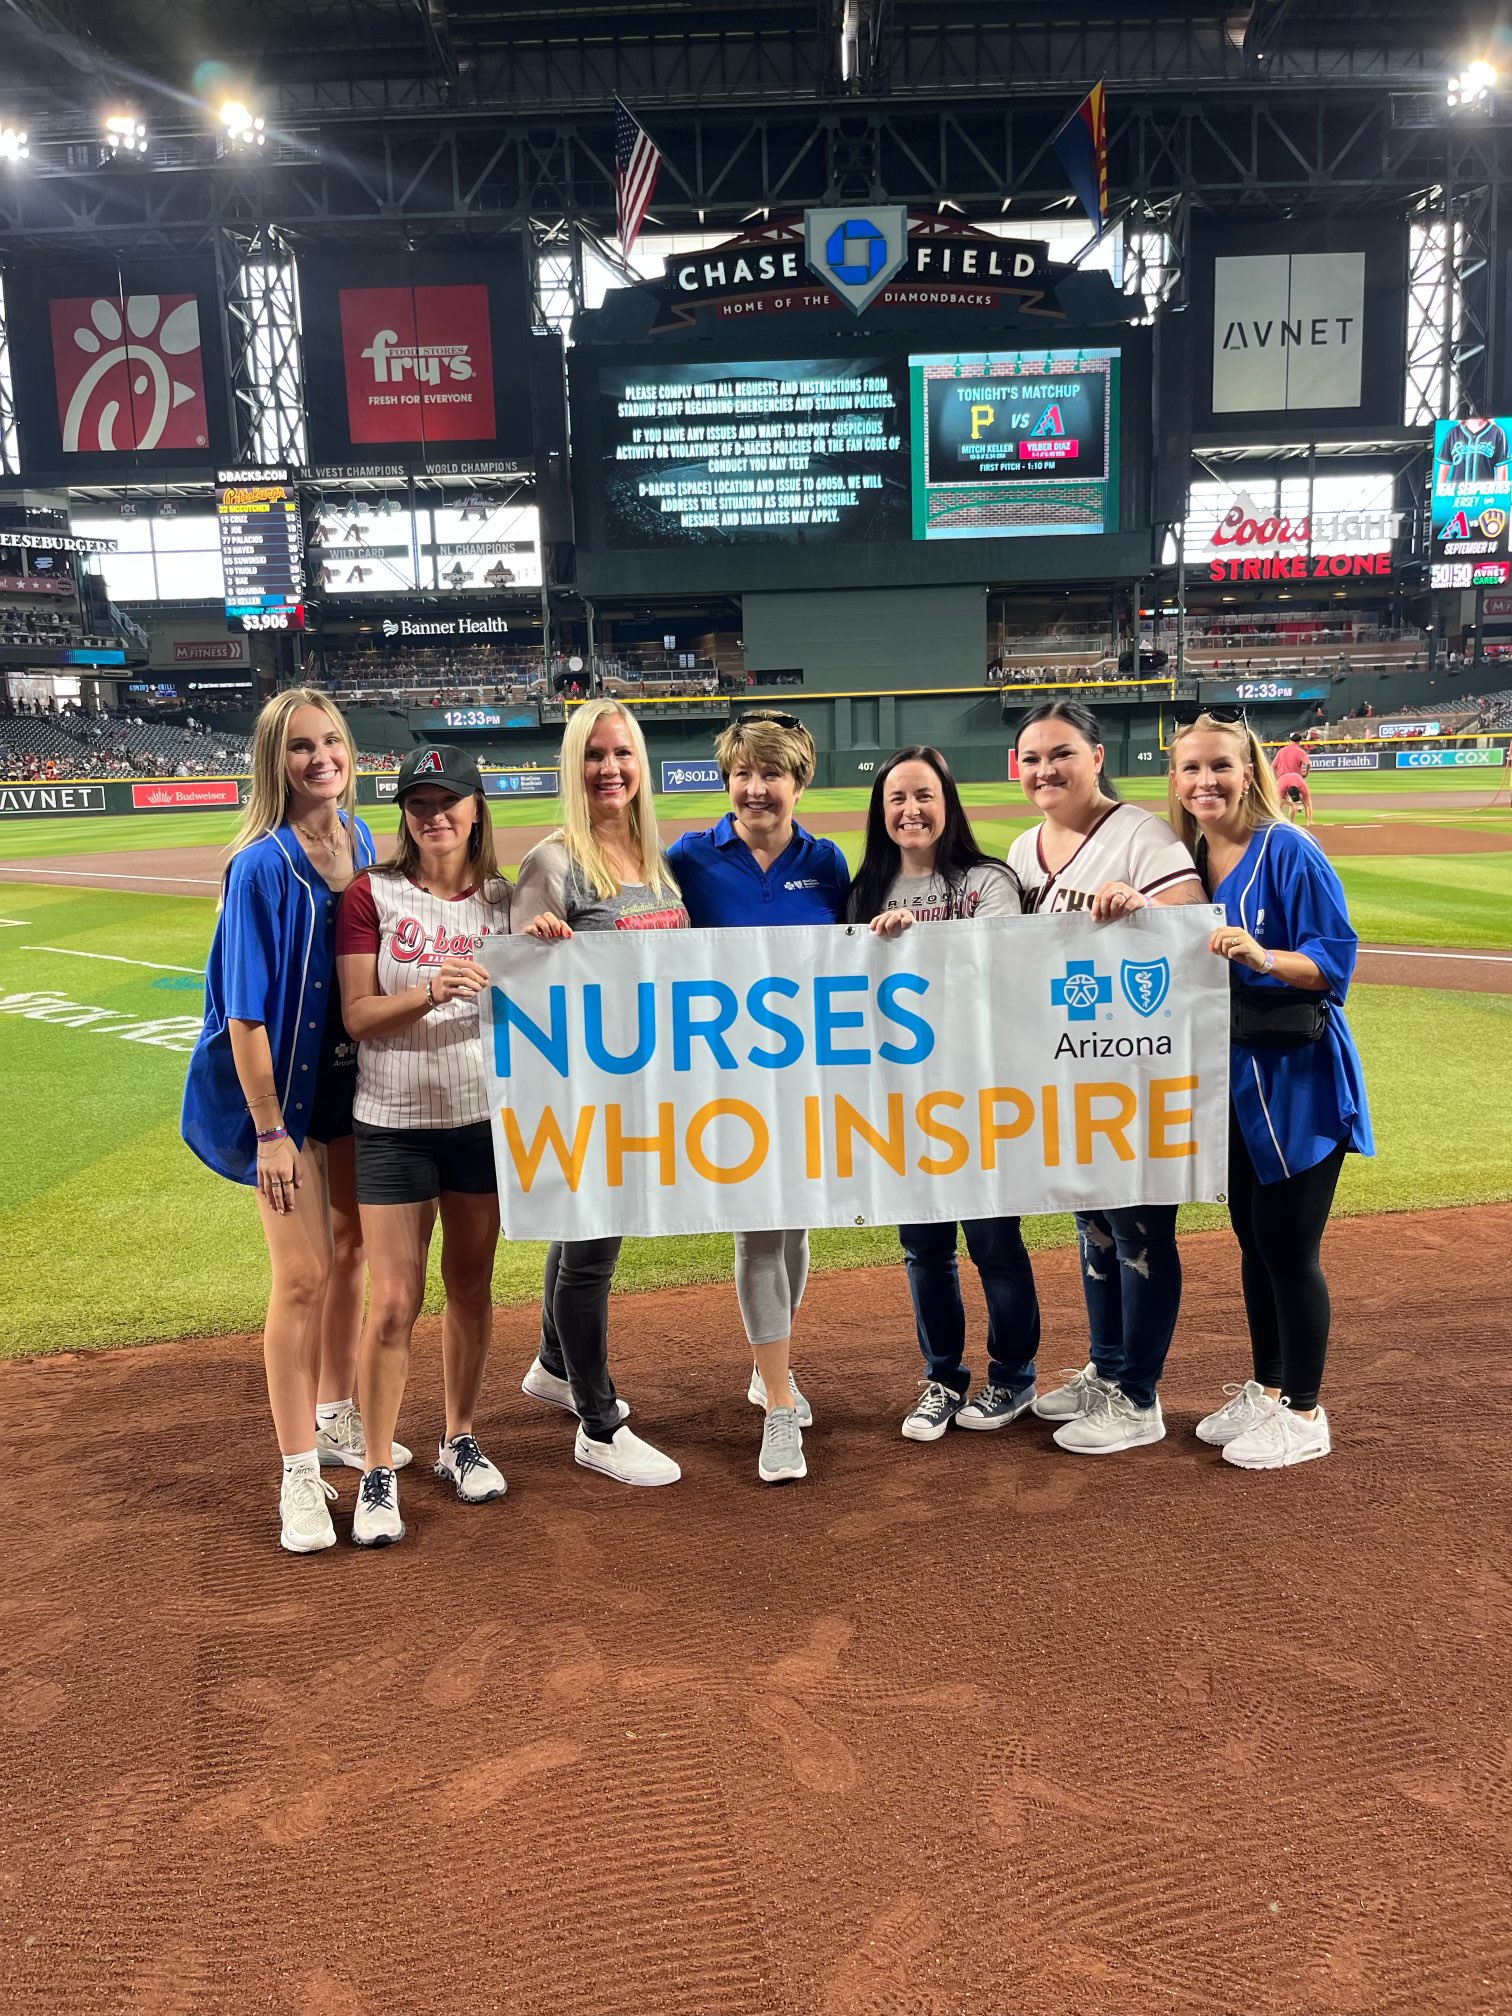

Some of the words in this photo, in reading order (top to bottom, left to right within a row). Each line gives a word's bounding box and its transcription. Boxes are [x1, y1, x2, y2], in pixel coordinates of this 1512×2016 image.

[678, 253, 797, 291] CHASE
[917, 248, 1035, 278] FIELD
[723, 301, 764, 315] HOME
[775, 298, 792, 309] OF
[803, 295, 830, 307] THE
[884, 292, 992, 305] DIAMONDBACKS
[1222, 316, 1353, 350] AVNET
[389, 347, 418, 356] FOOD
[423, 346, 465, 355] STORES
[626, 385, 657, 400] PLEASE
[659, 384, 692, 399] COMPLY
[694, 383, 716, 398] WITH
[718, 382, 733, 397] ALL
[735, 381, 778, 396] REQUESTS
[780, 381, 798, 394] AND
[800, 378, 861, 394] INSTRUCTIONS
[864, 378, 887, 392] FROM
[957, 386, 1018, 401] TONIGHT'S
[1022, 384, 1080, 399] MATCHUP
[368, 396, 398, 405] FRESH
[401, 395, 420, 404] FOR
[424, 394, 472, 403] EVERYONE
[618, 403, 656, 417] STADIUM
[658, 402, 683, 416] STAFF
[685, 400, 733, 415] REGARDING
[735, 398, 793, 413] EMERGENCIES
[795, 396, 813, 410] AND
[815, 396, 852, 410] STADIUM
[855, 394, 896, 408] POLICIES.
[1011, 414, 1030, 428] VS
[633, 428, 642, 442] IF
[644, 428, 661, 442] YOU
[663, 427, 685, 441] HAVE
[687, 427, 705, 440] ANY
[707, 426, 736, 440] ISSUES
[739, 424, 756, 439] AND
[758, 424, 782, 438] WANT
[784, 424, 795, 437] TO
[798, 423, 830, 437] REPORT
[832, 421, 883, 435] SUSPICIOUS
[616, 445, 655, 460] ACTIVITY
[656, 444, 670, 458] OR
[670, 443, 720, 458] VIOLATIONS
[722, 442, 732, 456] OF
[735, 441, 771, 455] D-BACKS
[774, 439, 811, 454] POLICIES
[813, 439, 826, 452] OR
[828, 438, 844, 452] THE
[846, 438, 862, 451] FAN
[864, 437, 886, 450] CODE
[889, 436, 900, 450] OF
[962, 445, 985, 454] MITCH
[987, 444, 1013, 453] KELLER
[1054, 442, 1070, 450] DIAZ
[426, 464, 458, 474] WORLD
[461, 461, 517, 473] CHAMPIONS
[708, 458, 747, 472] CONDUCT
[750, 458, 766, 471] YOU
[769, 457, 787, 470] MAY
[788, 456, 809, 470] TEXT
[980, 463, 999, 472] FIRST
[1000, 463, 1020, 471] PITCH
[1027, 462, 1042, 470] 1:10
[1044, 461, 1055, 469] PM
[218, 470, 287, 483] DBACKS.COM
[301, 468, 314, 478] NL
[316, 466, 344, 477] WEST
[346, 465, 404, 476] CHAMPIONS
[639, 482, 676, 496] D-BACKS
[678, 481, 712, 496] [SPACE]
[714, 479, 754, 494] LOCATION
[756, 478, 774, 492] AND
[776, 478, 801, 491] ISSUE
[803, 477, 814, 490] TO
[816, 476, 846, 489] 69050.
[848, 476, 860, 489] WE
[863, 474, 883, 488] WILL
[661, 498, 698, 512] ADDRESS
[700, 497, 717, 510] THE
[719, 495, 763, 509] SITUATION
[765, 495, 776, 508] AS
[778, 494, 801, 507] SOON
[803, 494, 814, 507] AS
[816, 492, 859, 506] POSSIBLE.
[230, 515, 248, 523] CRUZ
[681, 513, 720, 527] MESSAGE
[722, 513, 739, 526] AND
[741, 512, 762, 525] DATA
[764, 511, 790, 524] RATES
[792, 510, 810, 523] MAY
[811, 508, 839, 522] APPLY.
[1211, 506, 1311, 546] Coors
[1315, 512, 1406, 543] LIGHT
[232, 536, 264, 544] PALACIOS
[330, 549, 355, 559] WILD
[358, 548, 384, 558] CARD
[440, 545, 452, 555] NL
[455, 543, 516, 554] CHAMPIONS
[1444, 542, 1487, 555] SEPTEMBER
[1488, 541, 1498, 553] 14
[1210, 556, 1307, 582] STRIKE
[1313, 552, 1392, 577] ZONE
[242, 614, 288, 631] $3,906
[401, 620, 455, 634] Banner
[458, 618, 508, 633] Health
[190, 648, 227, 657] FITNESS
[1137, 753, 1152, 761] 413
[1337, 756, 1370, 767] Health
[1409, 754, 1442, 765] COX
[1455, 752, 1489, 764] COX
[858, 762, 874, 771] 407
[0, 790, 92, 810] AVNET
[176, 791, 226, 801] Budweiser
[492, 973, 935, 1078] NURSES
[1054, 1032, 1171, 1060] Arizona
[500, 1098, 770, 1193] WHO
[804, 1075, 1198, 1179] INSPIRE
